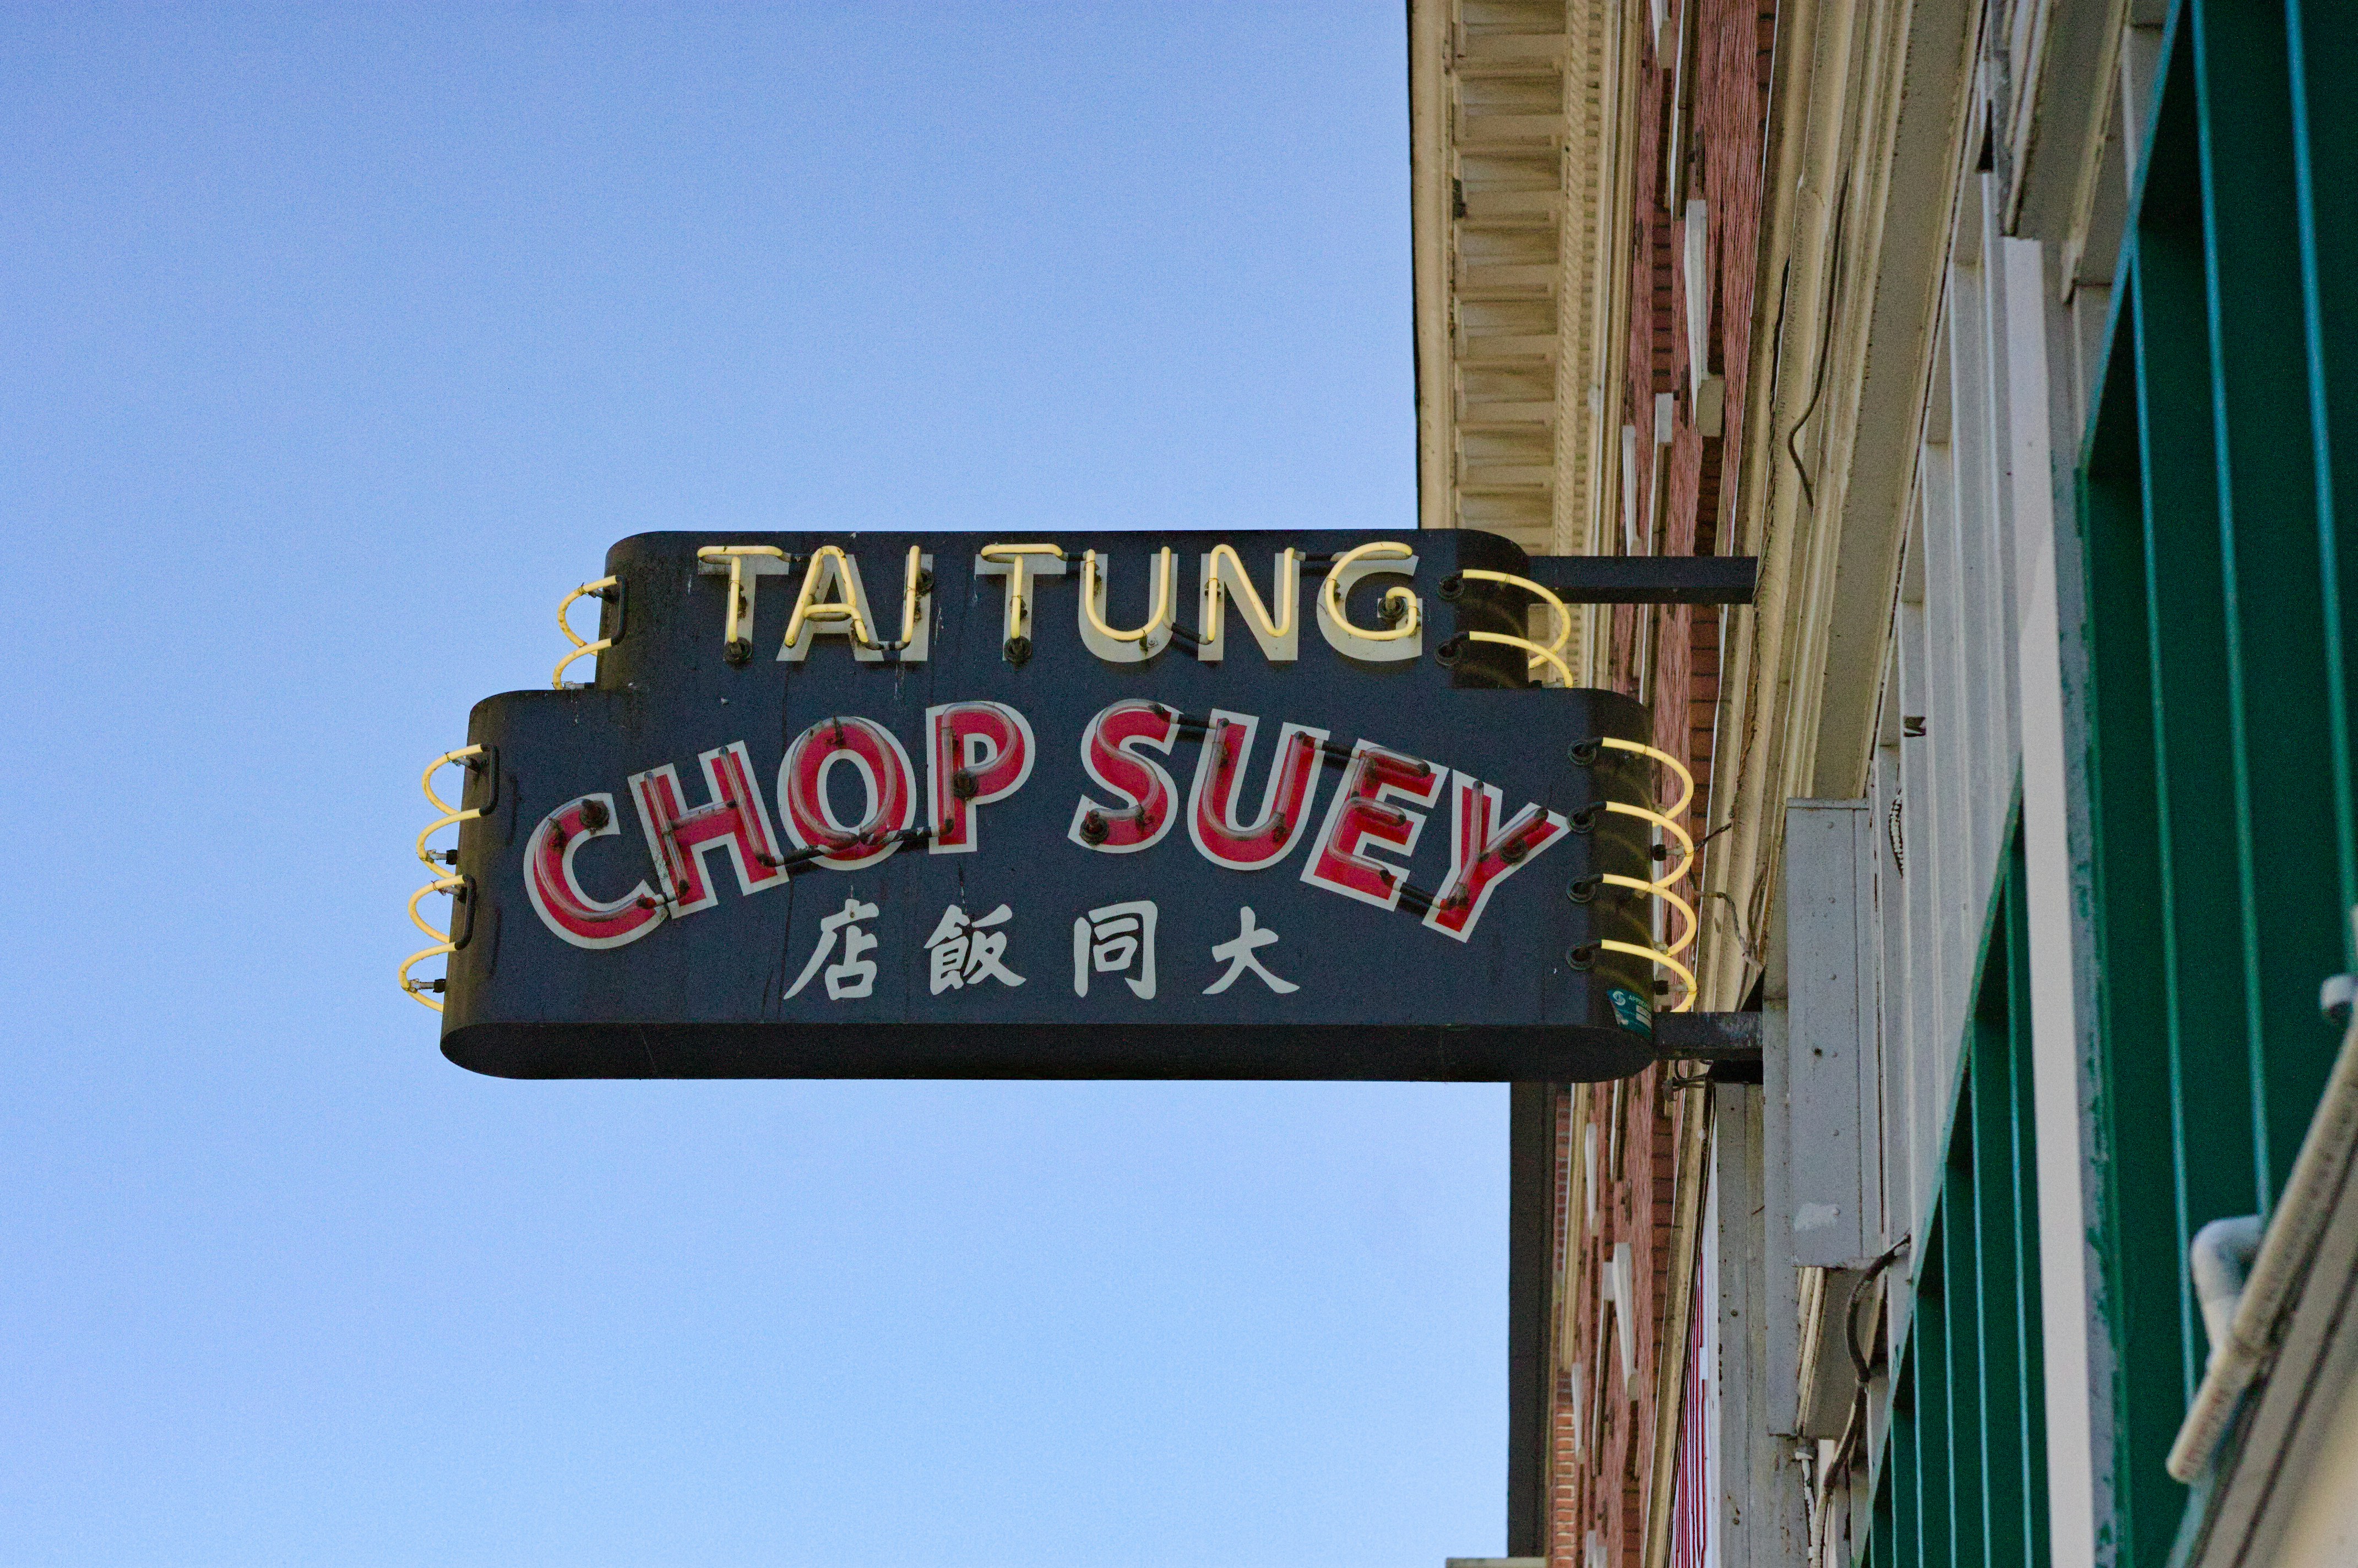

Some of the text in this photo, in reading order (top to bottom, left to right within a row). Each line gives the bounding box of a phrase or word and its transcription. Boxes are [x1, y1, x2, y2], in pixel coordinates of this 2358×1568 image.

[696, 541, 1424, 663] TAI TUNG
[523, 698, 1569, 950] CHOP SUEY
